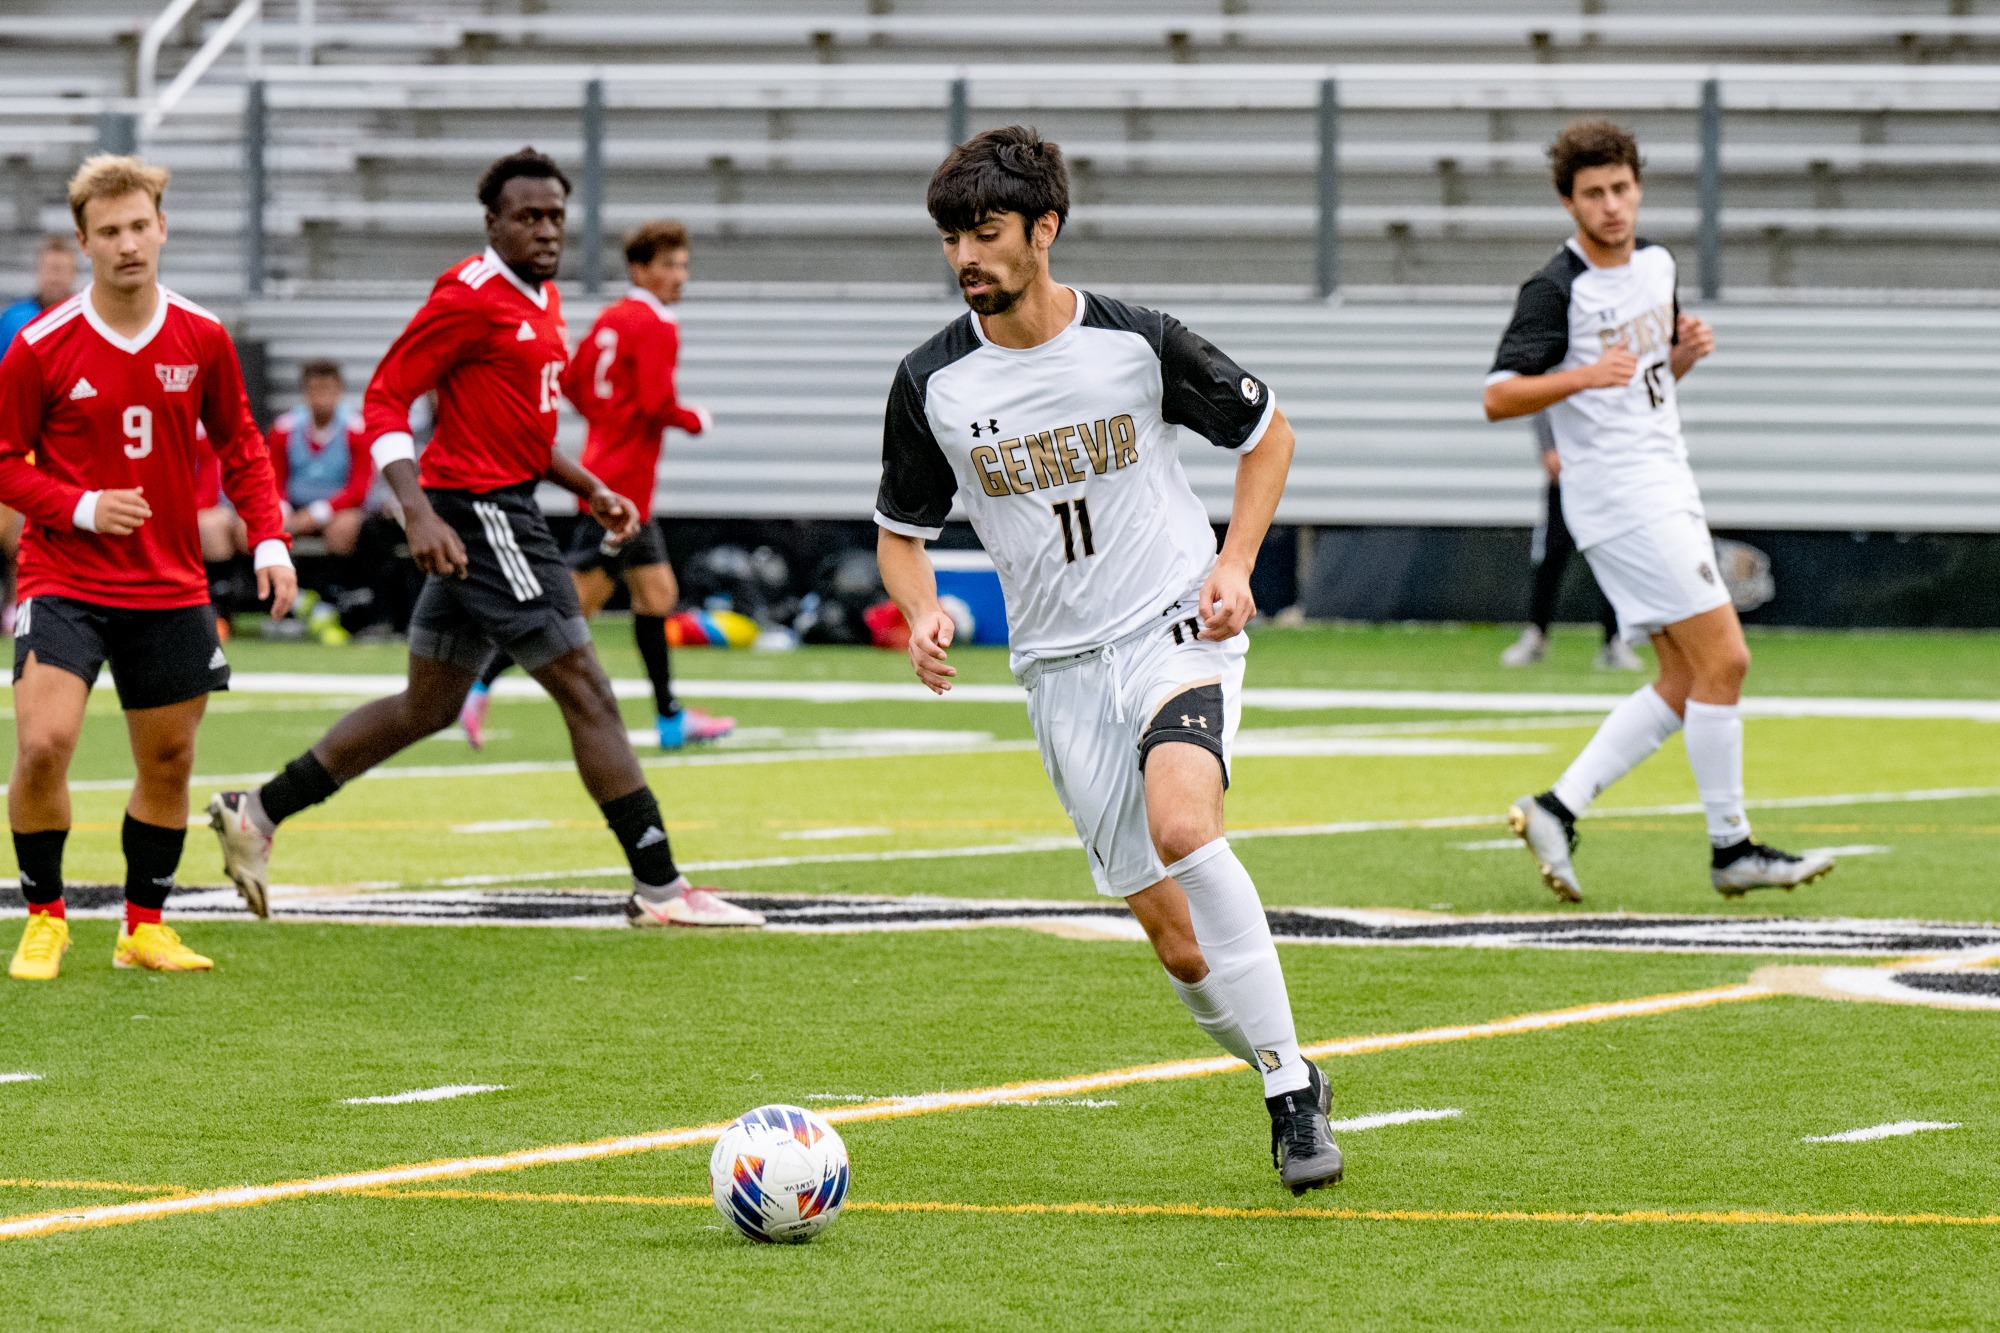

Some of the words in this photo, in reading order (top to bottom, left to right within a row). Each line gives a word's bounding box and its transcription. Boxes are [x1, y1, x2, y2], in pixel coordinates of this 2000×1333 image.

[539, 360, 566, 413] 15
[594, 326, 619, 399] 2
[122, 405, 153, 459] 9
[970, 413, 1139, 498] GENEVA
[1052, 496, 1096, 564] 11
[1172, 617, 1201, 646] 11
[783, 1178, 816, 1192] GENEVA
